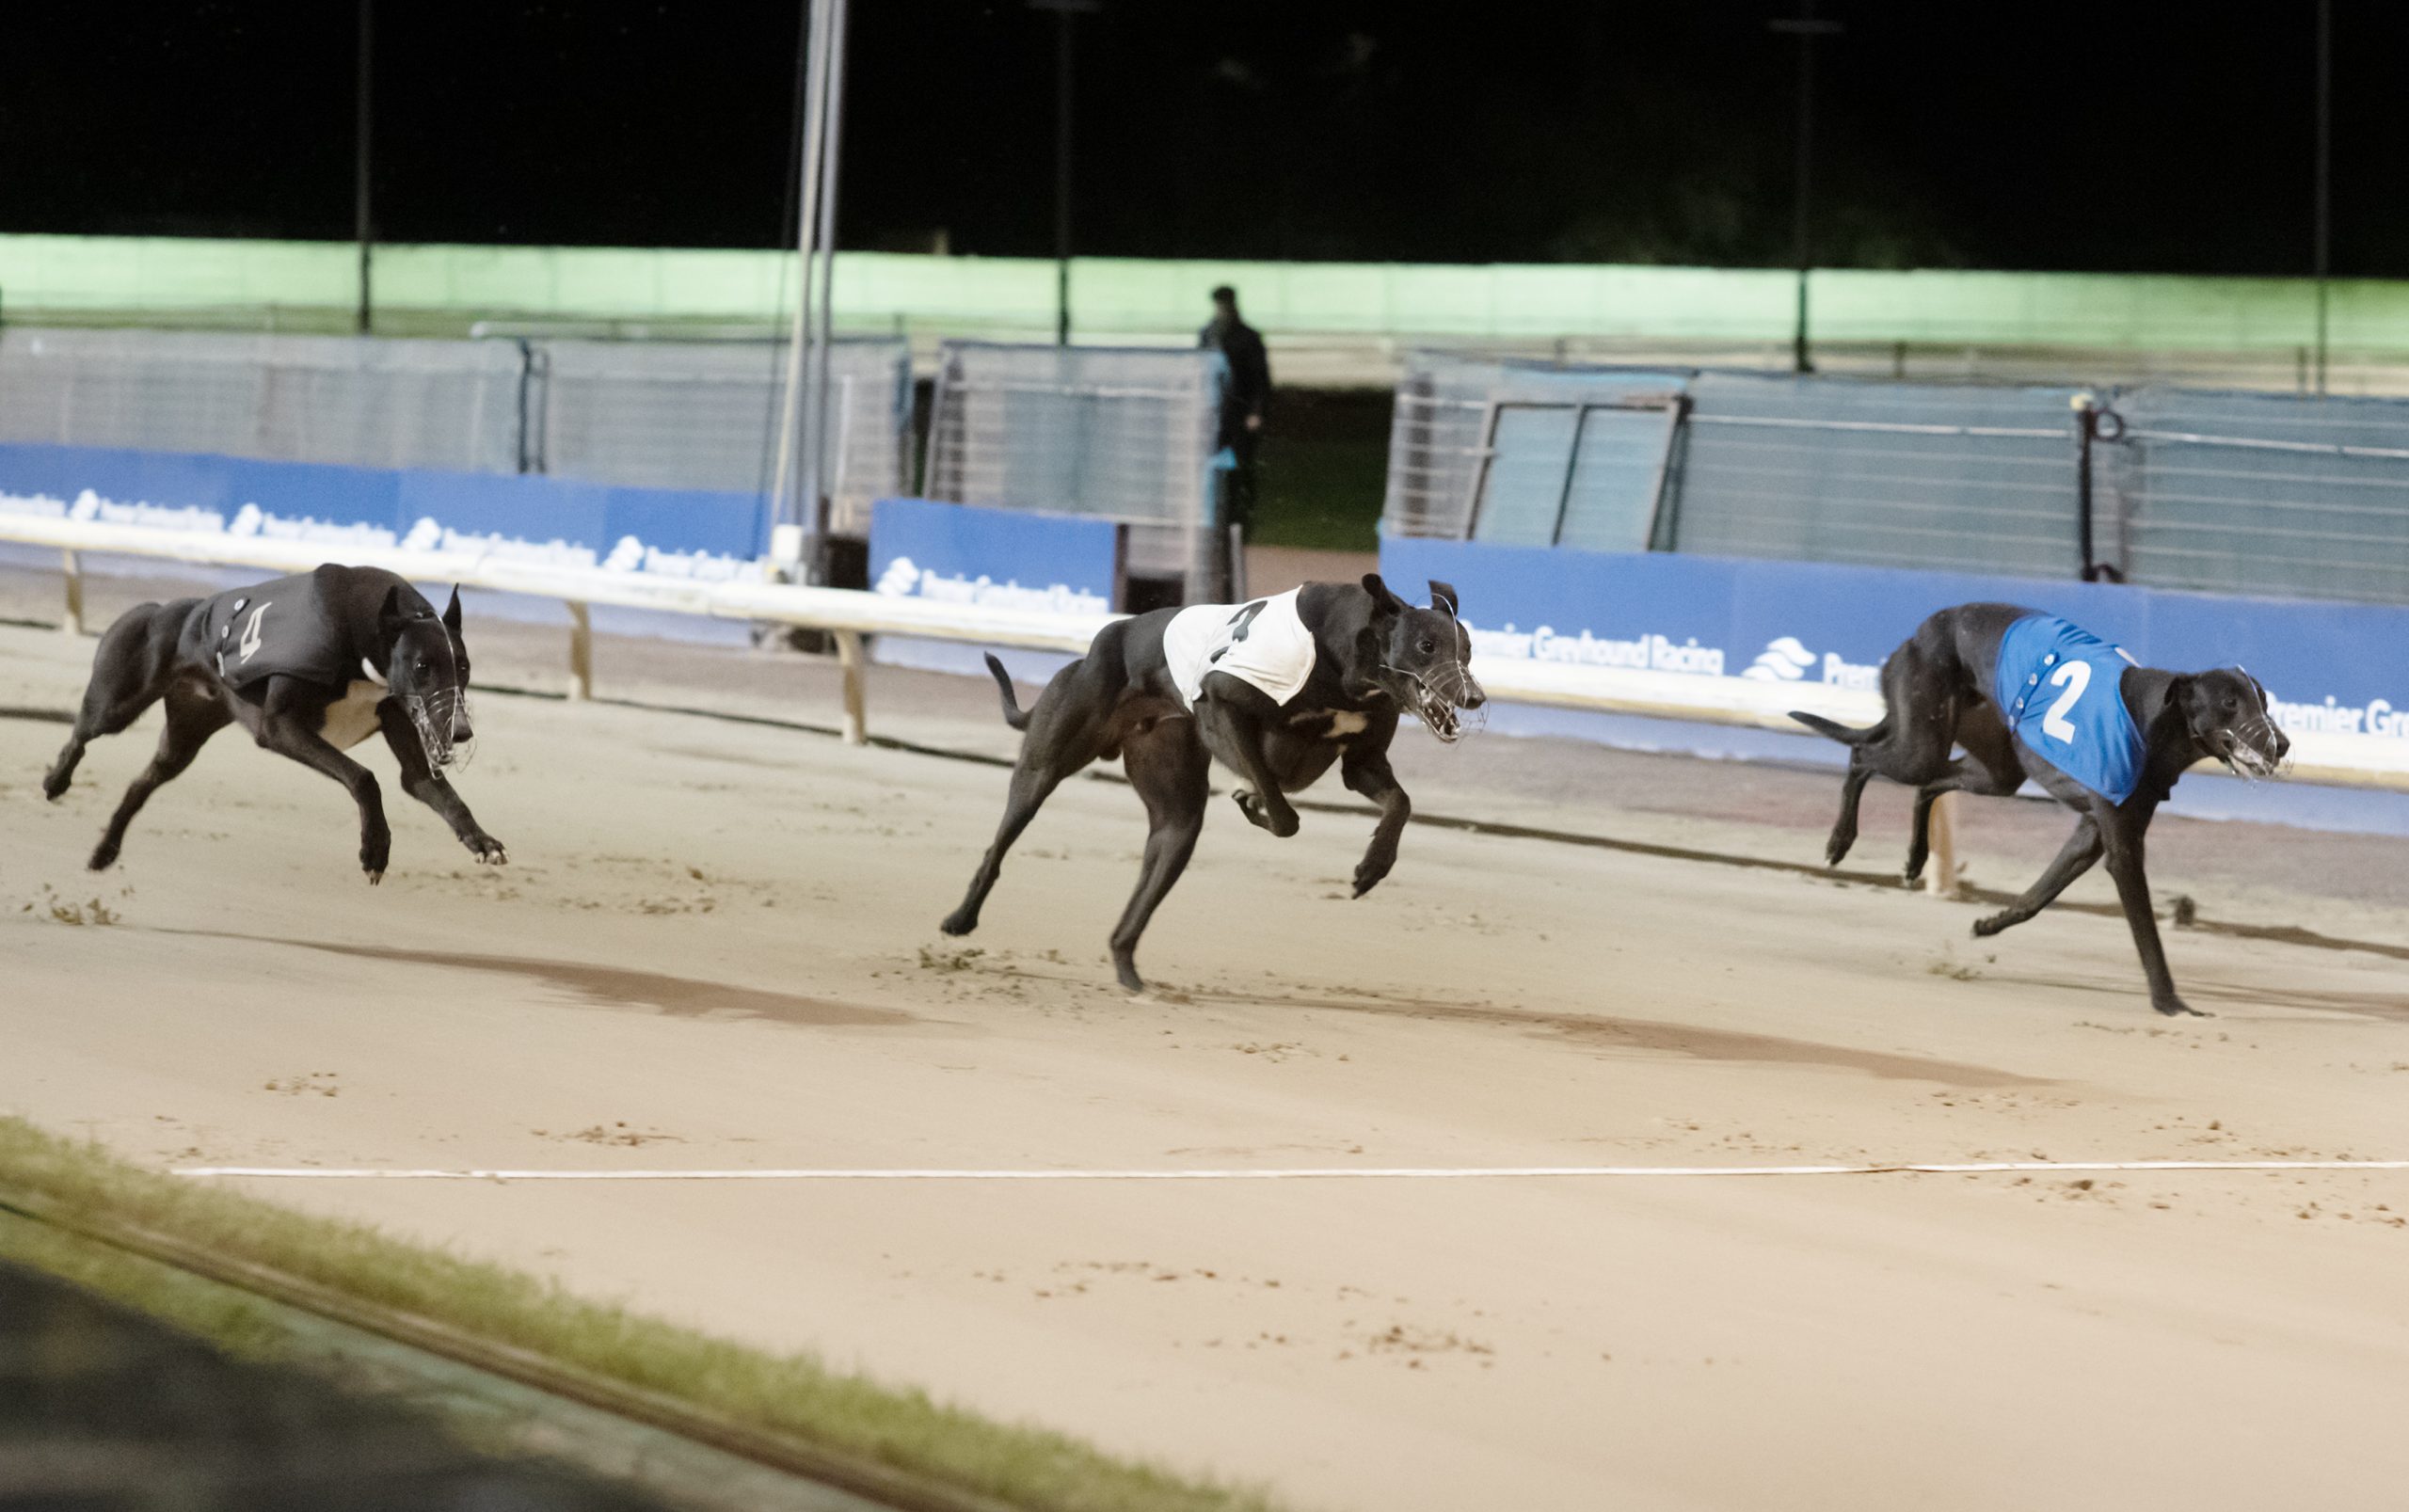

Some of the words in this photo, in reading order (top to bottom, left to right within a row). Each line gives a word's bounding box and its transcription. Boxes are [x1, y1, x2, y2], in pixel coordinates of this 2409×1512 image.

[240, 601, 272, 664] 4
[1648, 634, 1724, 676] Racing
[2042, 660, 2092, 745] 2
